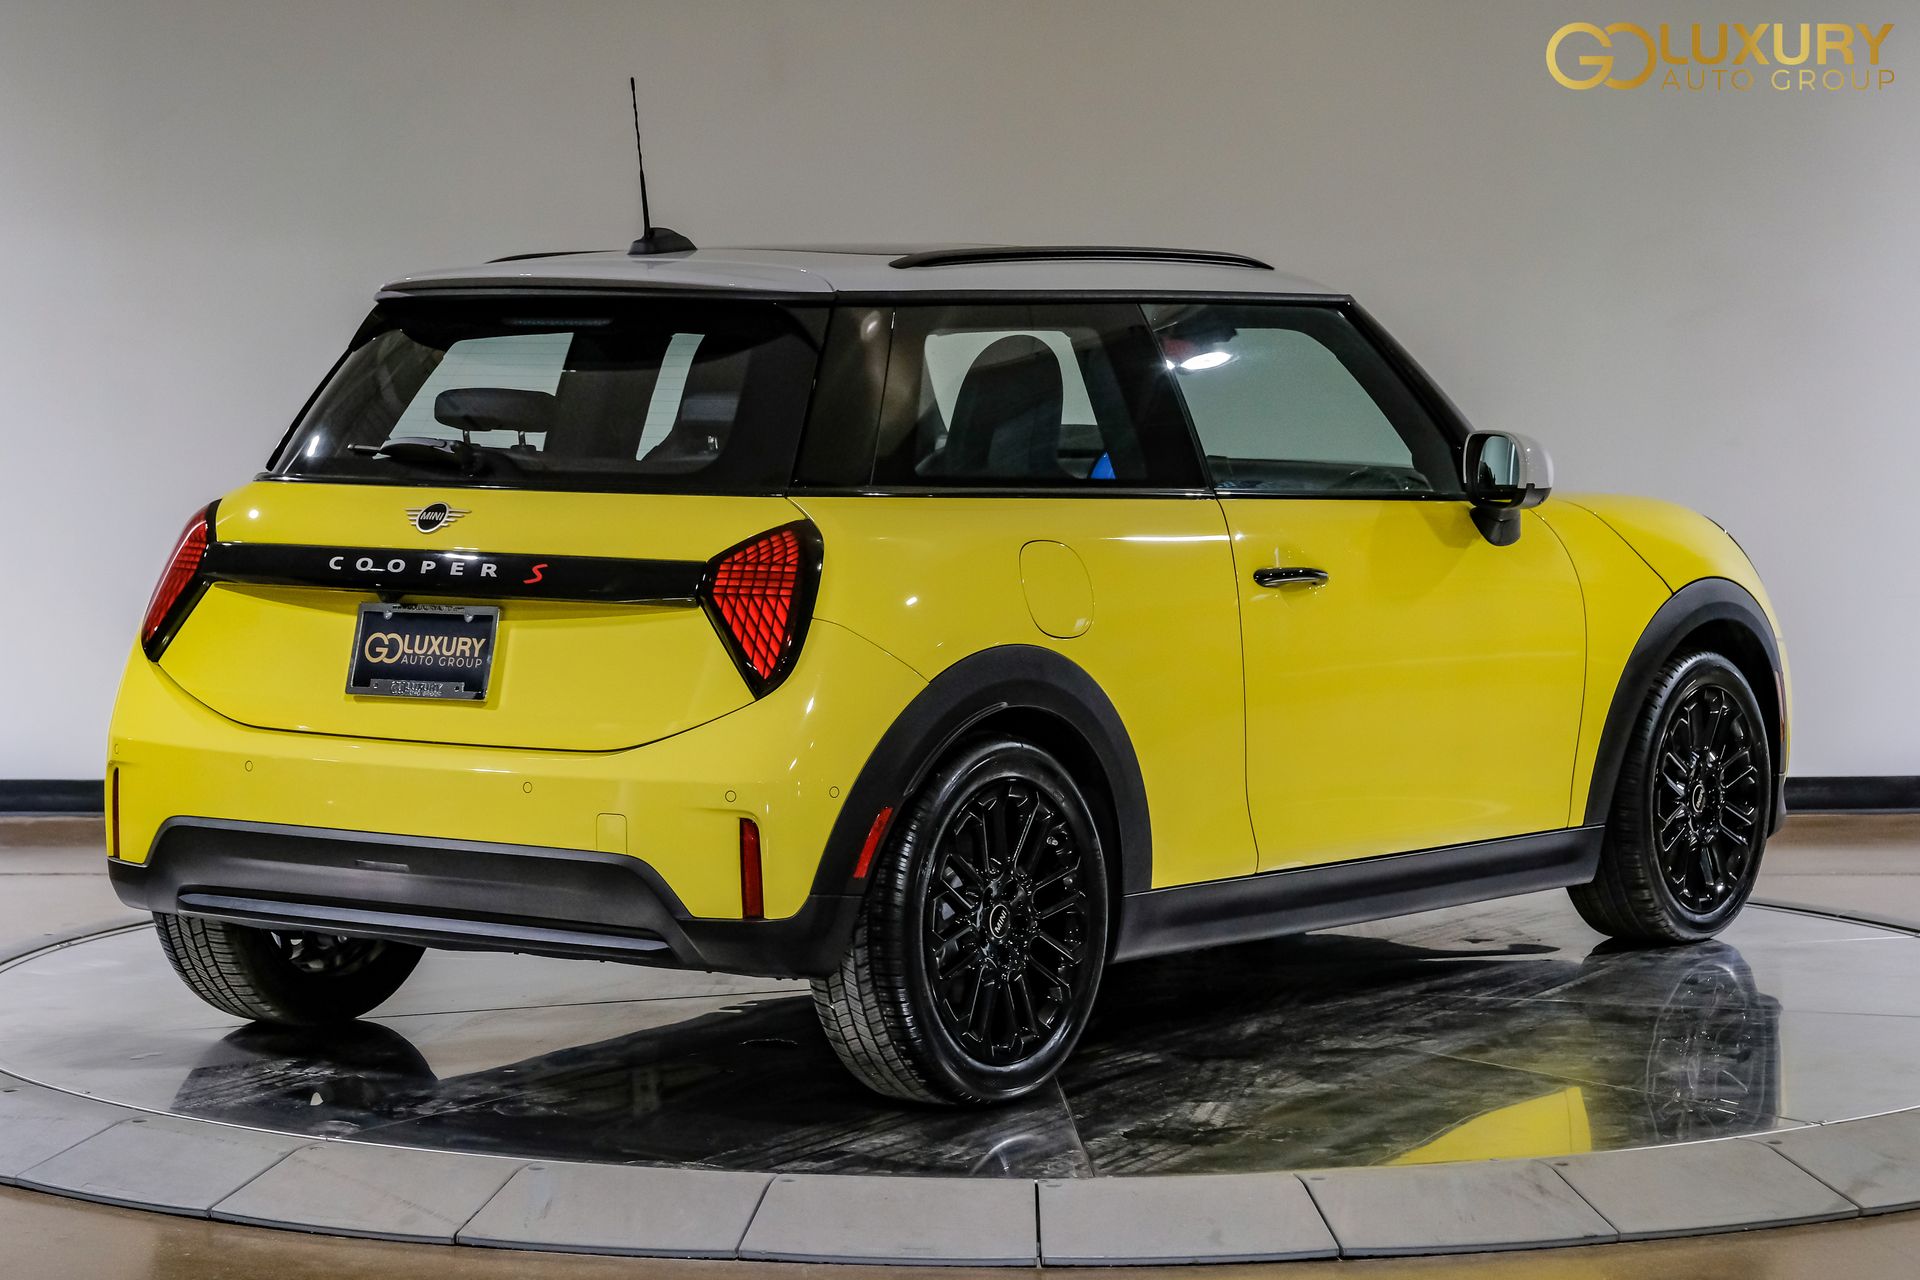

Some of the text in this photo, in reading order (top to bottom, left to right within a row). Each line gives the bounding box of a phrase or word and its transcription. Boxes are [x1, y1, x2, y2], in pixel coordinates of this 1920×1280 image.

[420, 511, 445, 521] MINI
[328, 556, 549, 585] COOPER S
[403, 634, 487, 658] LUXURY
[401, 655, 483, 668] AUTO GROUP
[994, 909, 1007, 934] MINI
